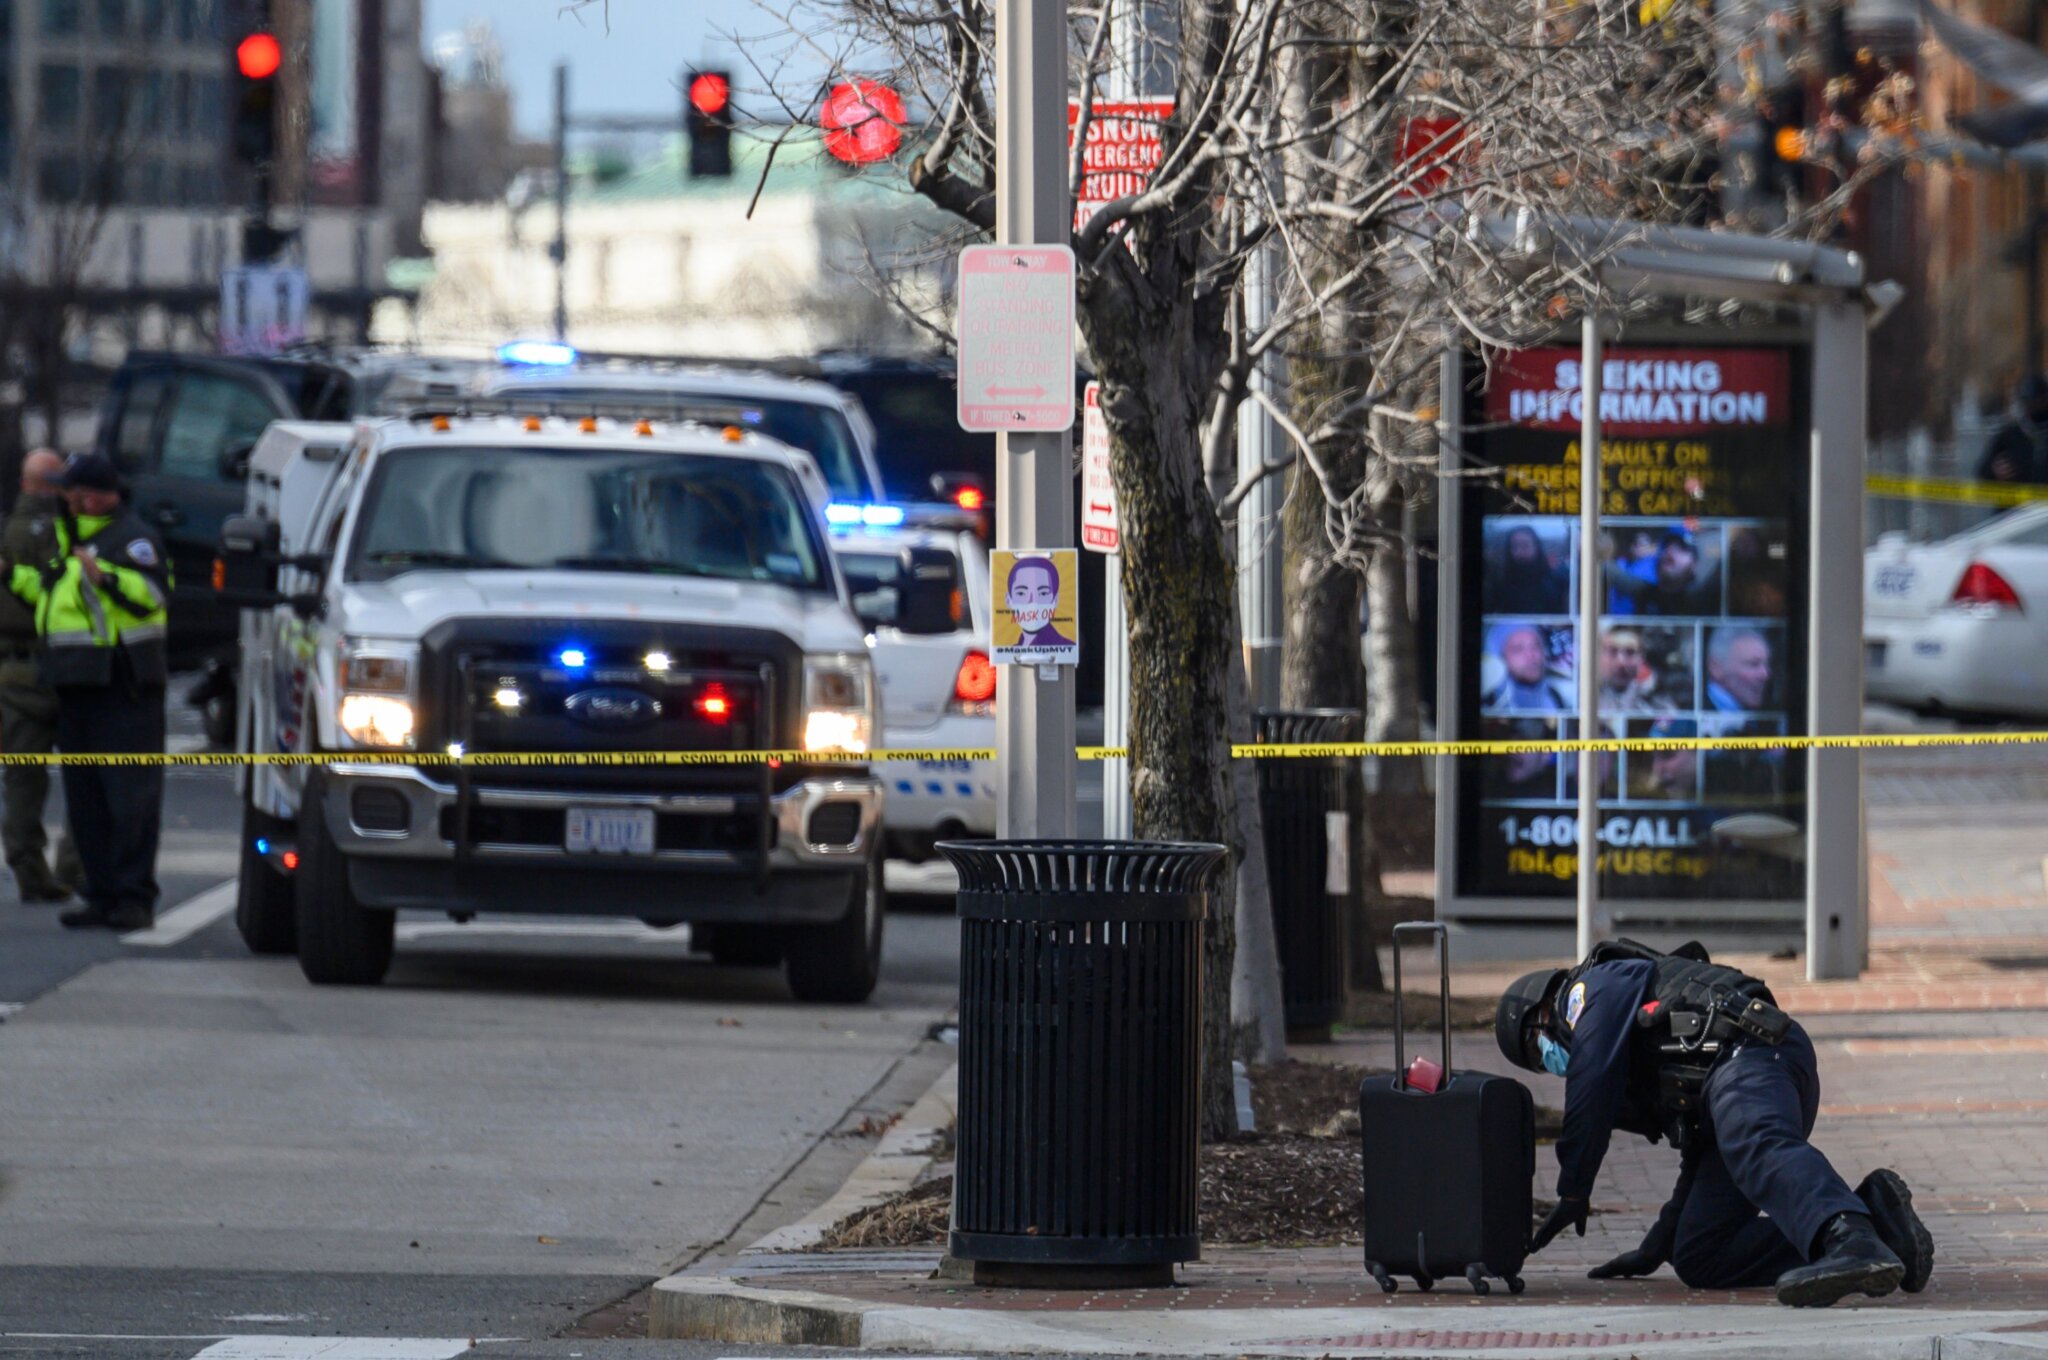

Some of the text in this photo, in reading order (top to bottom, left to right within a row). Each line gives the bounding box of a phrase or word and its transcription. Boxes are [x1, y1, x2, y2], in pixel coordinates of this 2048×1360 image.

[1086, 111, 1160, 142] SNOW
[1083, 144, 1163, 167] MERGENC
[1087, 169, 1149, 199] ROUT
[987, 254, 1048, 268] TOW WAY
[1005, 278, 1029, 293] NO
[980, 297, 1055, 315] STANDING
[970, 318, 1063, 335] OR PARKING
[989, 341, 1042, 357] METRO
[975, 360, 1056, 377] BUS ZONE
[1555, 359, 1721, 392] SEKING
[1564, 440, 1710, 466] ASAULT ON
[1503, 463, 1611, 491] FEDERL
[1011, 609, 1039, 624] MASK
[1041, 608, 1057, 620] ON
